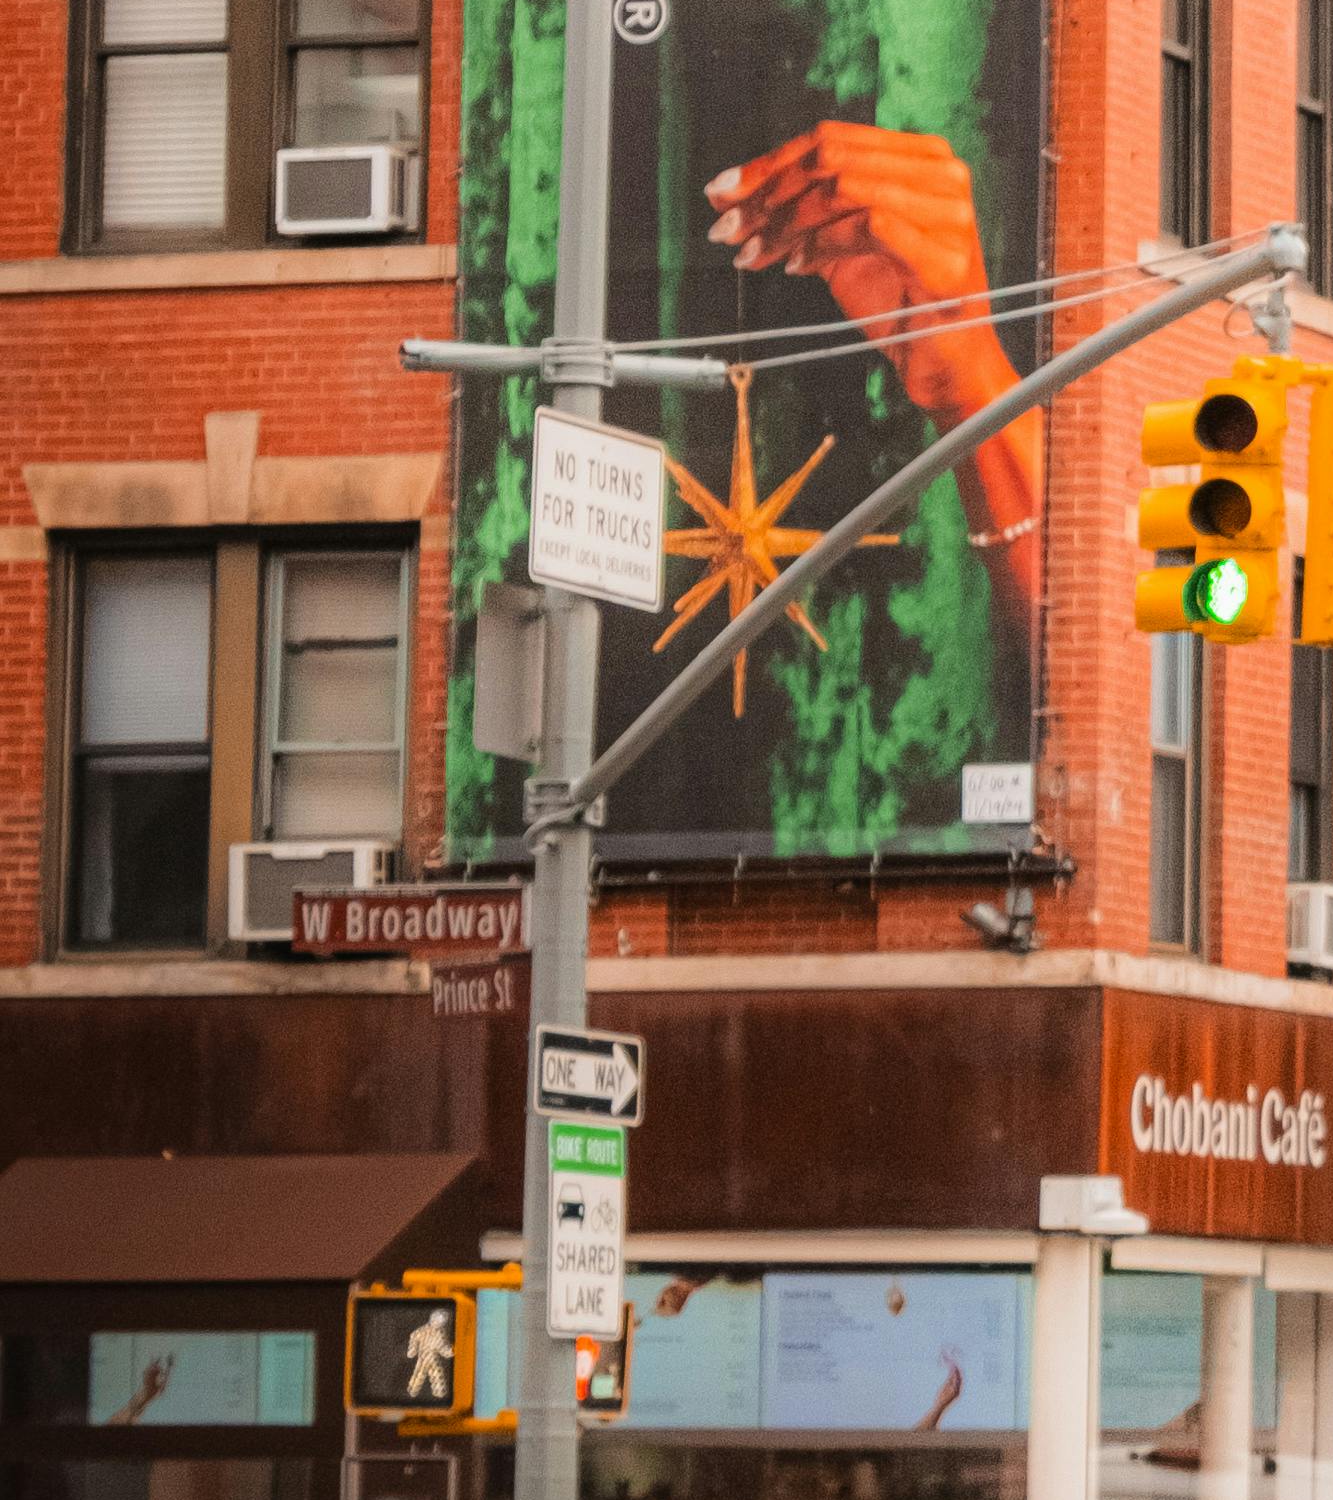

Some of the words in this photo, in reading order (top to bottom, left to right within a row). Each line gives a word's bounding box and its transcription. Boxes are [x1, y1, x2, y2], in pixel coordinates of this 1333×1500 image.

[554, 450, 576, 481] NO
[587, 458, 643, 501] TURNS
[543, 493, 574, 529] FOR
[586, 505, 651, 549] TRUCKS
[302, 901, 332, 942] W
[346, 896, 519, 948] Broadway
[432, 971, 489, 1015] Prince
[494, 967, 512, 1010] St
[546, 1055, 576, 1089] ONE
[594, 1061, 625, 1093] WAY
[1131, 1074, 1257, 1161] Chobani
[1260, 1087, 1327, 1168] Café
[556, 1241, 616, 1275] SHARED
[566, 1284, 605, 1317] LANE
